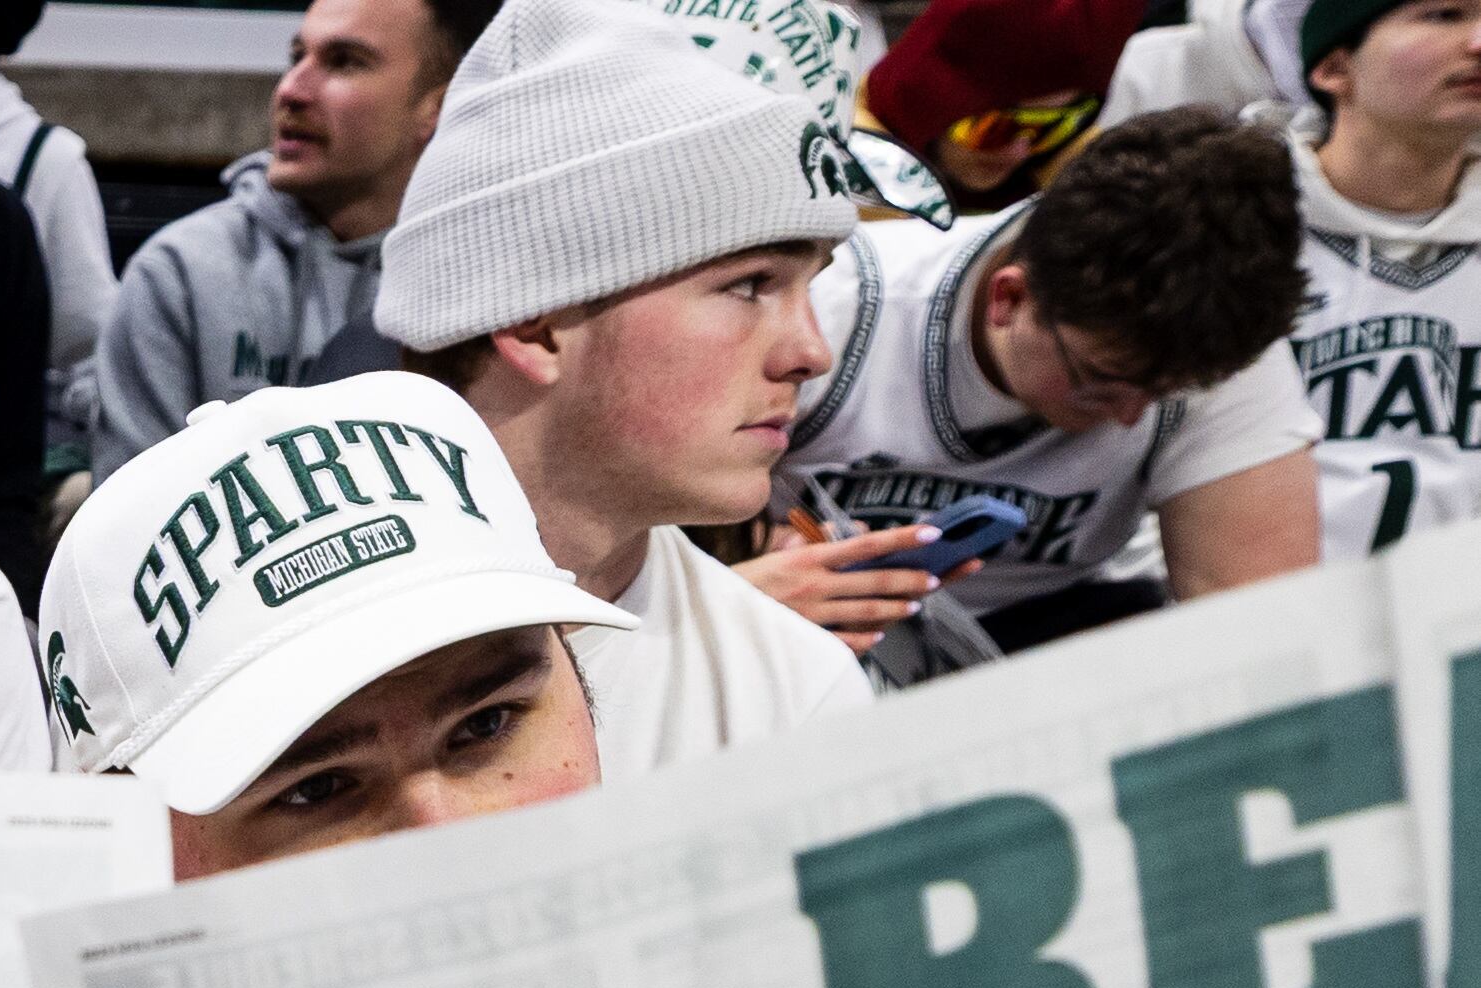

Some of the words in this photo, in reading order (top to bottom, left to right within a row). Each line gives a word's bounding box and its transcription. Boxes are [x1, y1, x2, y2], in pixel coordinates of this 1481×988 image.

[133, 419, 490, 670] SPARTY
[263, 540, 350, 599] MICHIGAN
[353, 520, 408, 561] STATE
